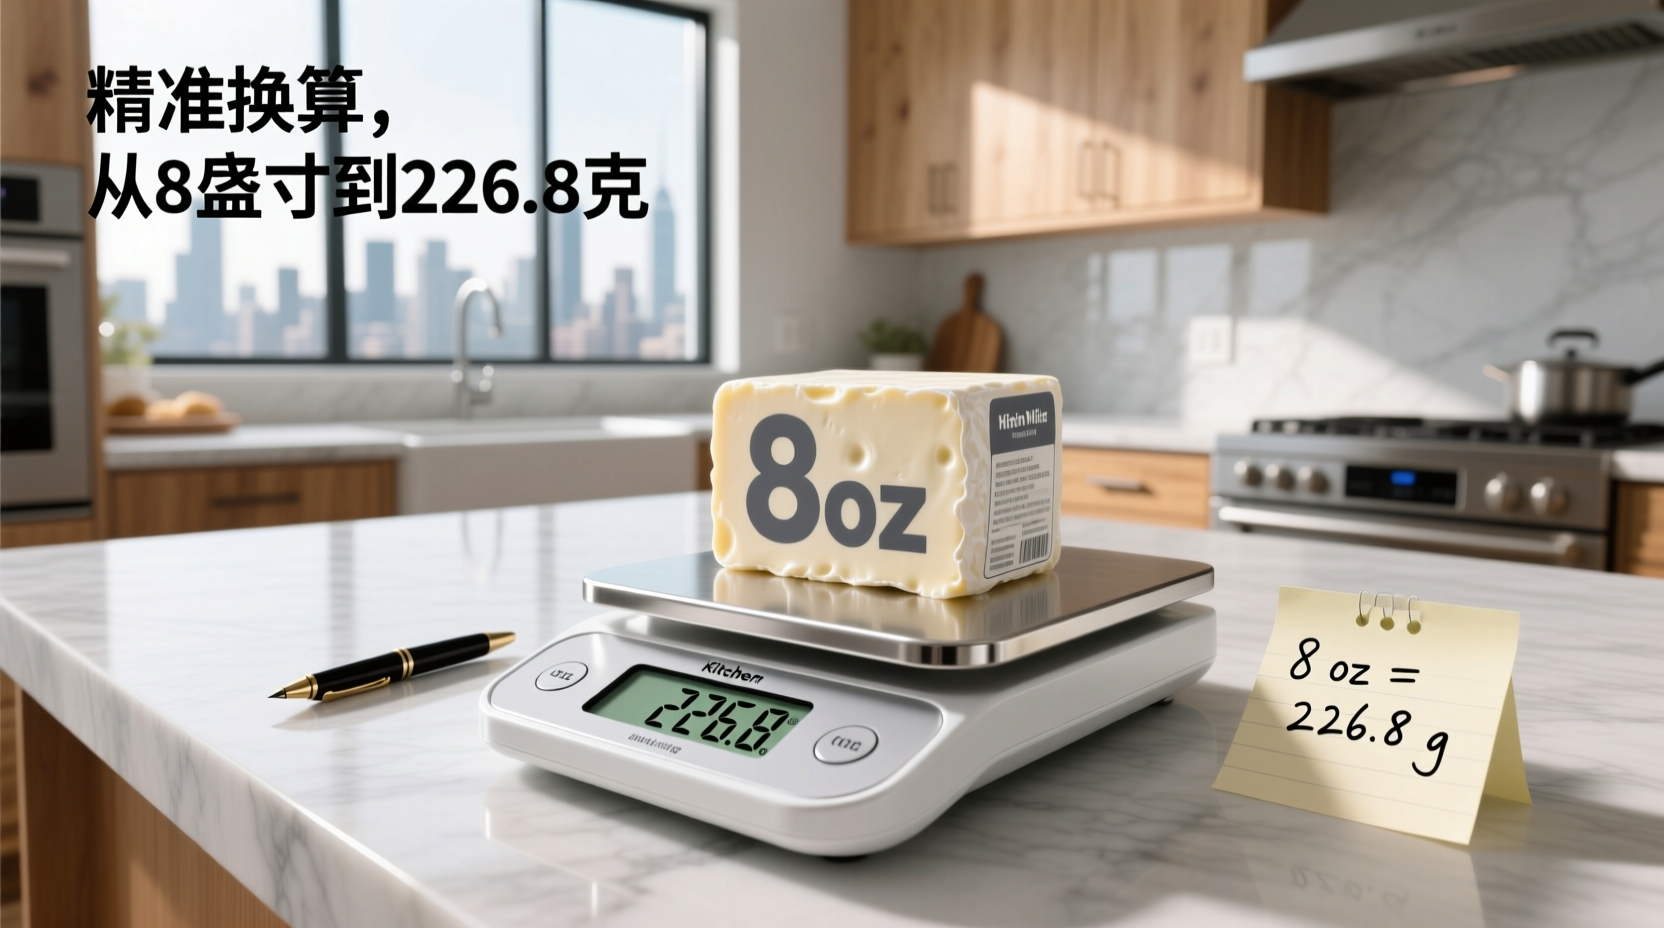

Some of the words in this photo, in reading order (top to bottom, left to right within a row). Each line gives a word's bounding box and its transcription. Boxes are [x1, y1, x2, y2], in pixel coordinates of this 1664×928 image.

[1289, 637, 1320, 680] 8
[1329, 660, 1371, 686] oz
[644, 687, 790, 752] 226.8
[1286, 701, 1412, 746] 226.8
[1412, 731, 1449, 777] g
